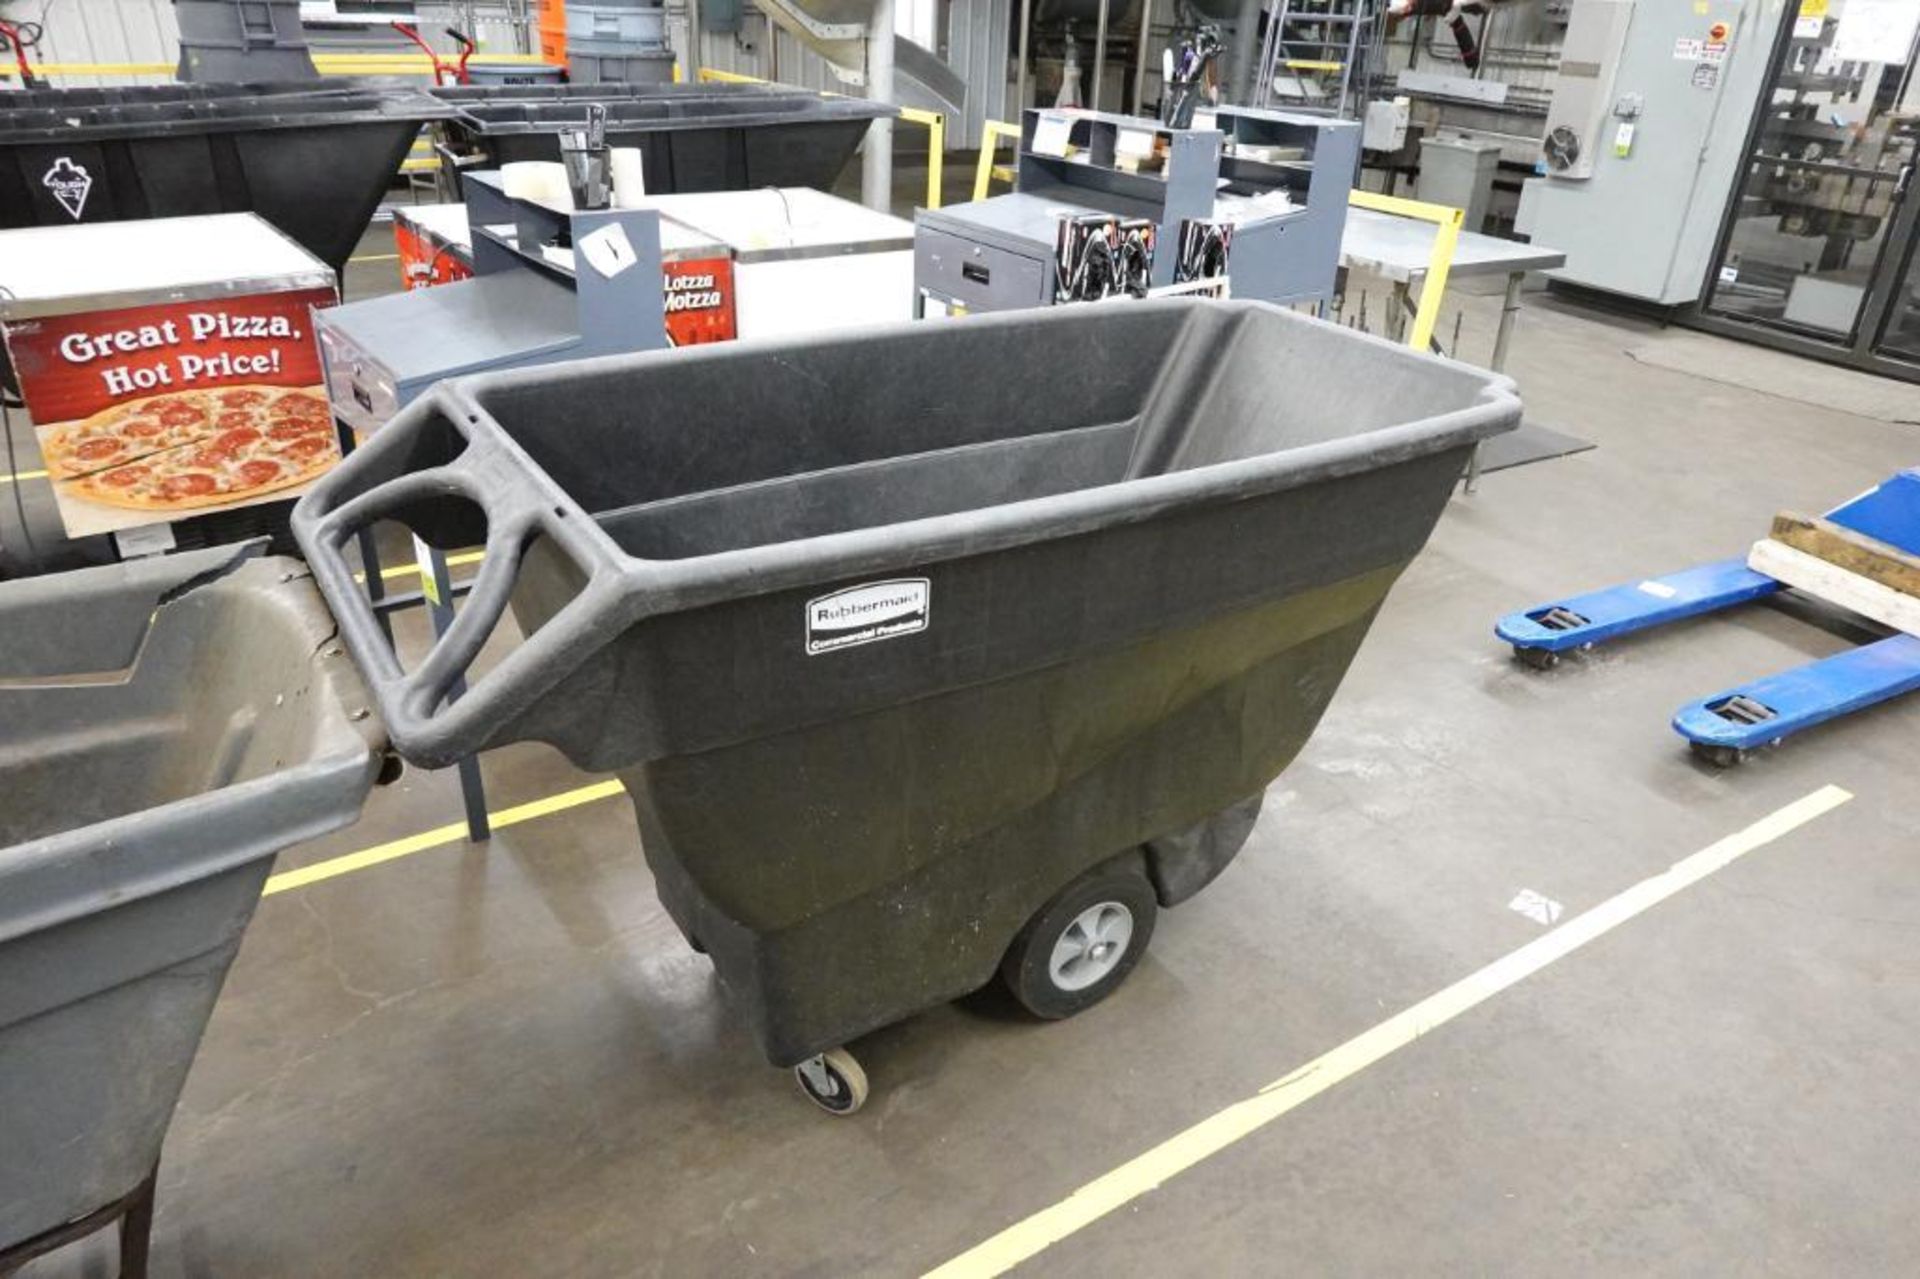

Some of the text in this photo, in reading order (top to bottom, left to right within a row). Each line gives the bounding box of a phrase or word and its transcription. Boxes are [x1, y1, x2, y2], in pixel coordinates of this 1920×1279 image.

[663, 273, 714, 292] Lotzza
[60, 311, 302, 362] Great Pizza,
[101, 348, 282, 395] Hot Price!
